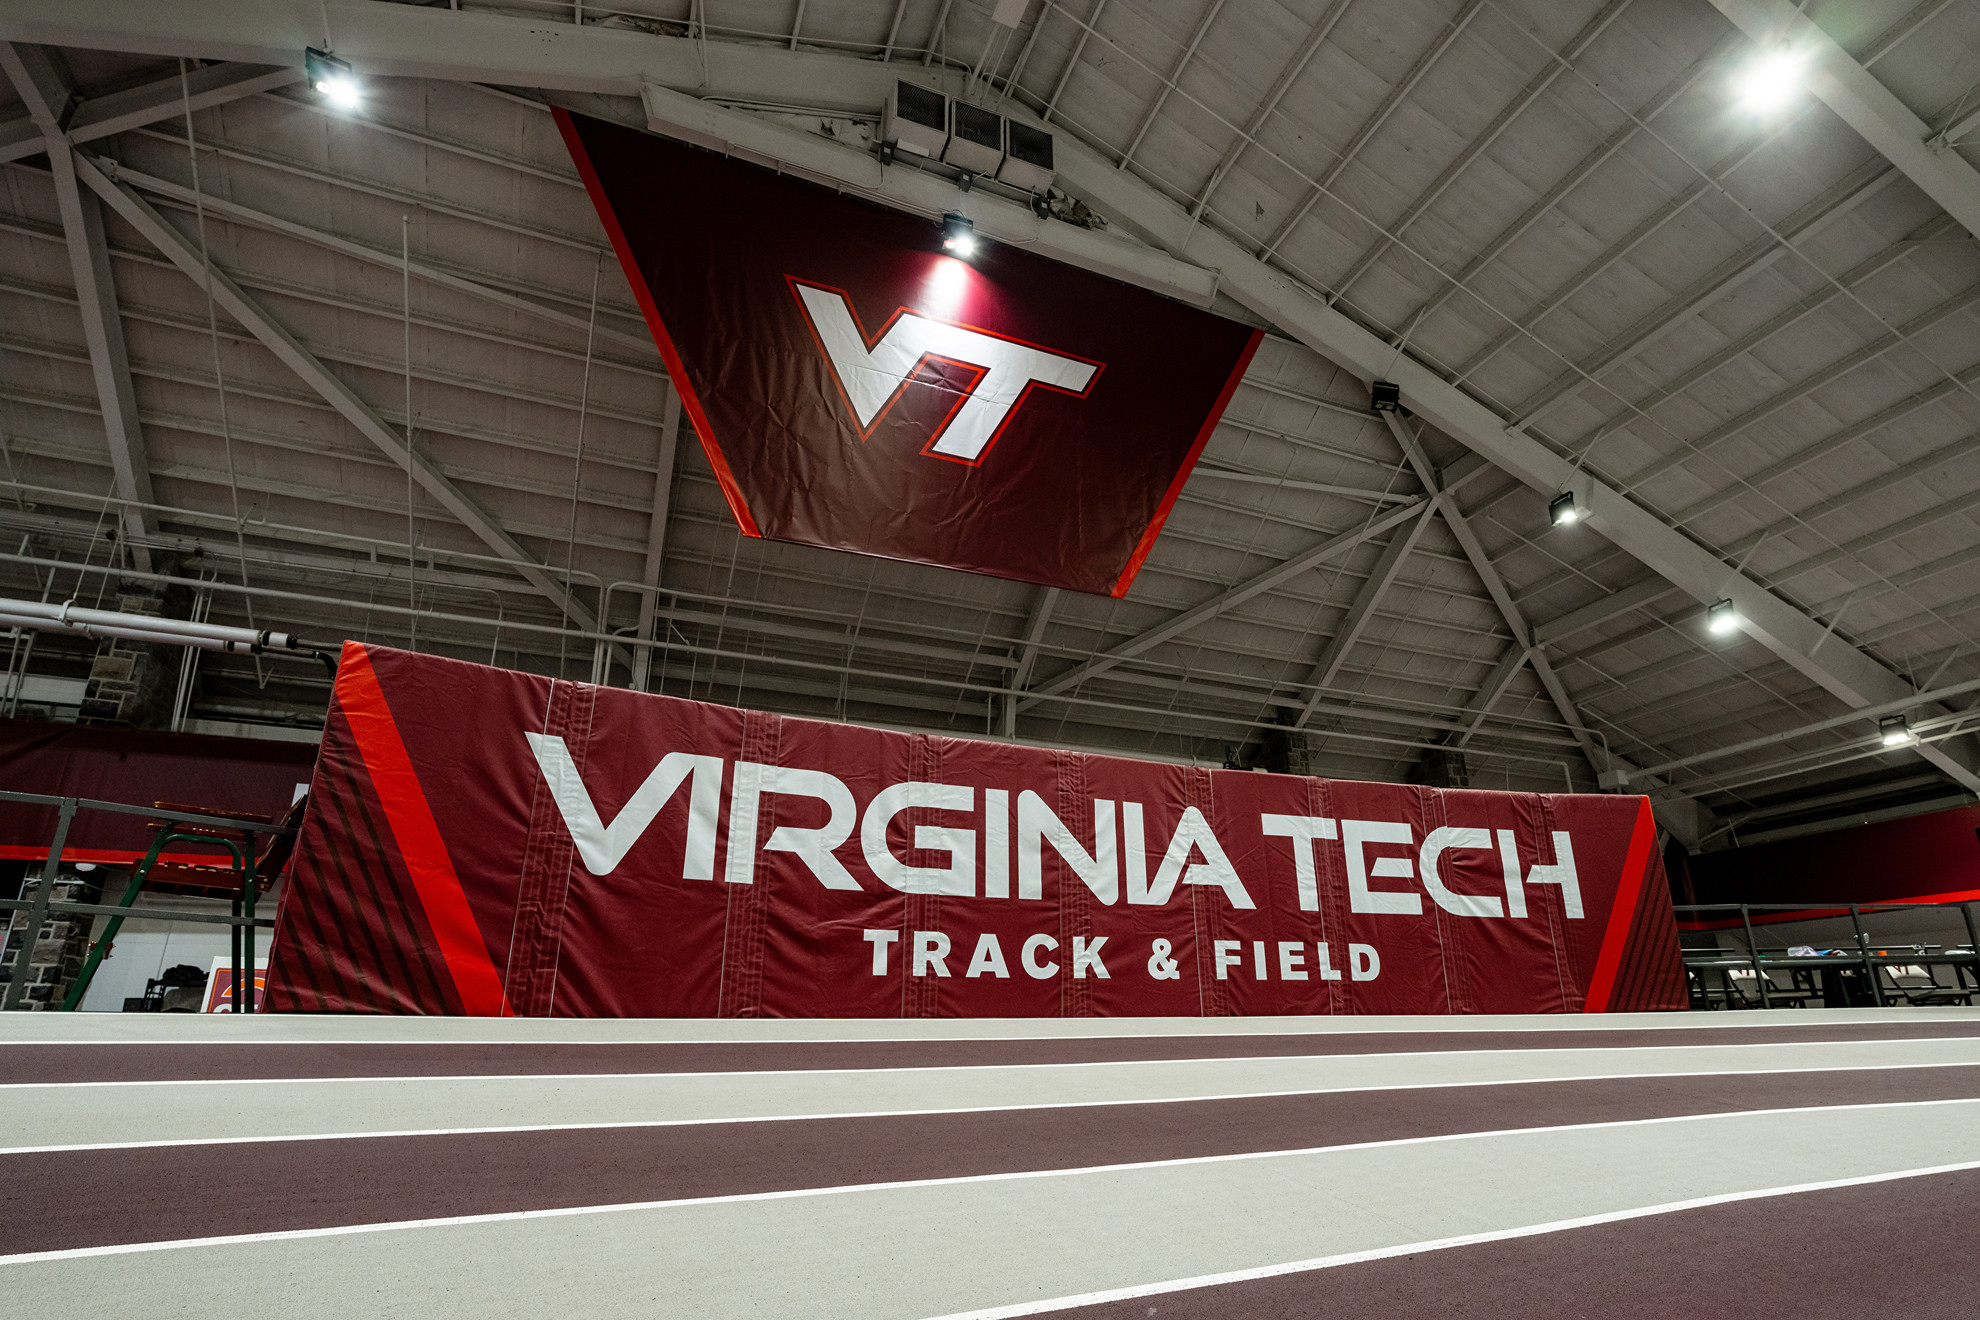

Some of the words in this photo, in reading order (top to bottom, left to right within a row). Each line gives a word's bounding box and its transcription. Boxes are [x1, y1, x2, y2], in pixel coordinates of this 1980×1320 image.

[784, 274, 1107, 467] VT
[524, 731, 1257, 910] VIRGINIA
[1261, 812, 1585, 919] TECH
[863, 929, 1112, 979] TRACK
[1147, 938, 1180, 980] &
[1214, 939, 1381, 982] FIELD
